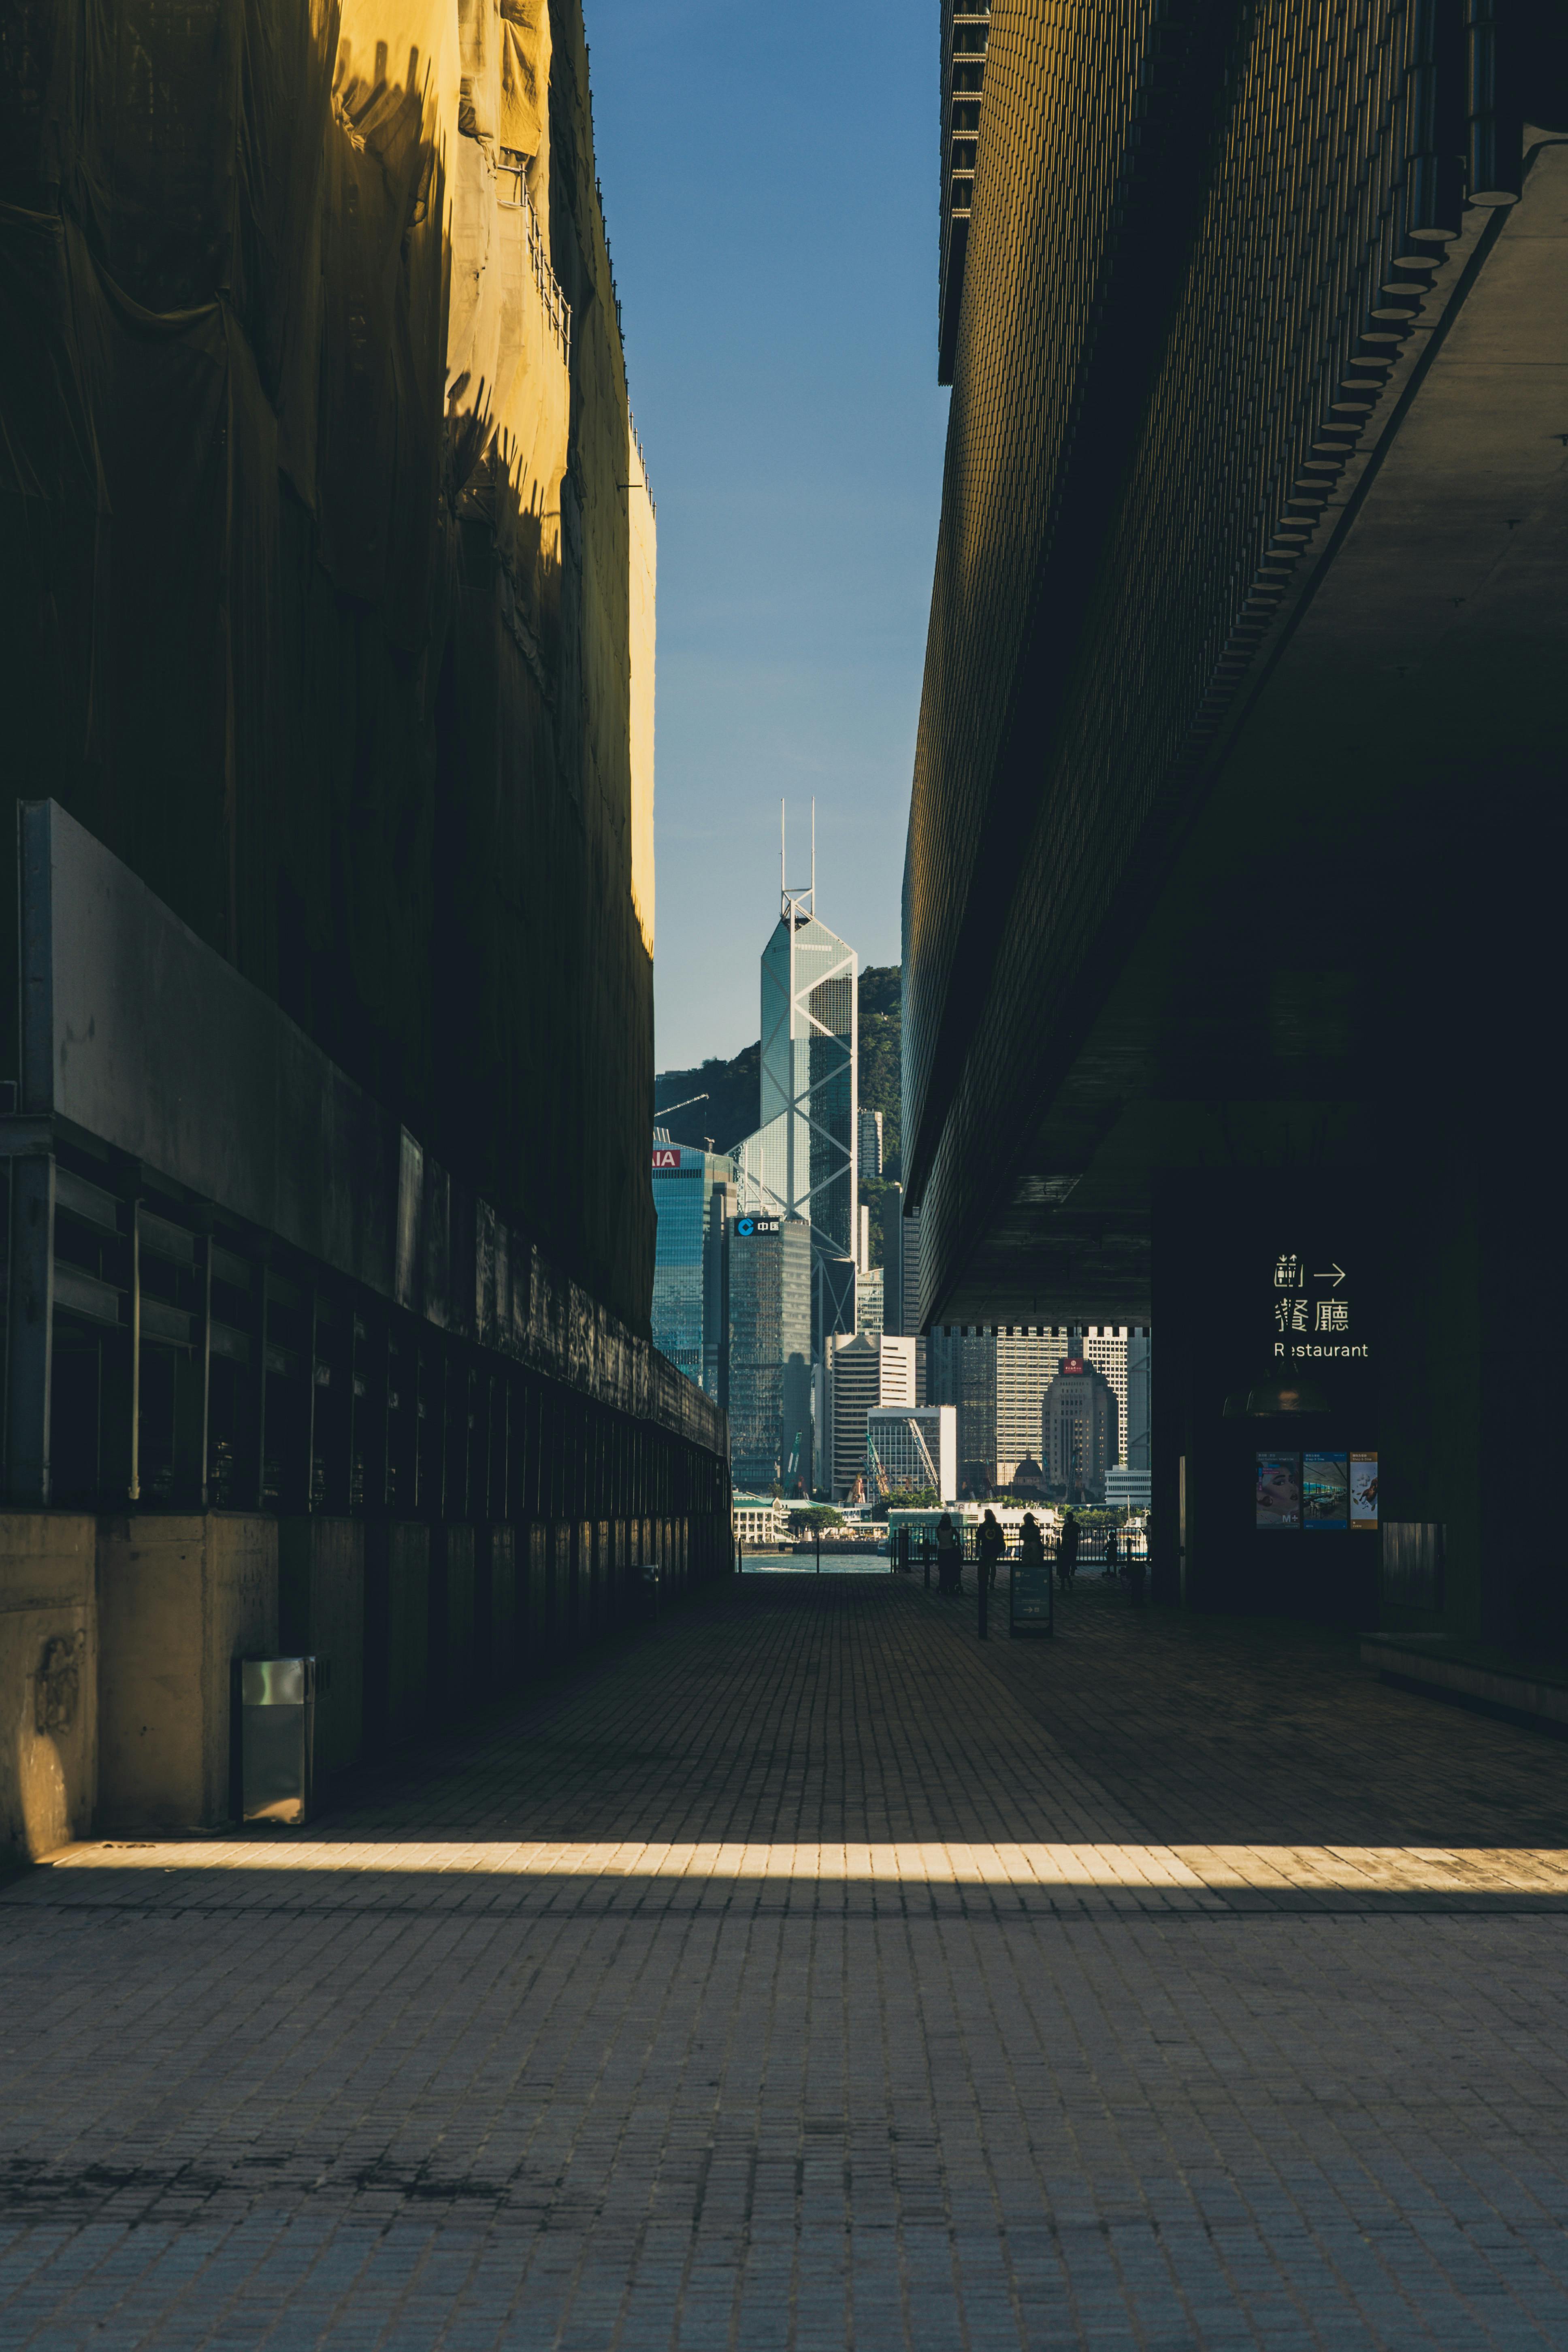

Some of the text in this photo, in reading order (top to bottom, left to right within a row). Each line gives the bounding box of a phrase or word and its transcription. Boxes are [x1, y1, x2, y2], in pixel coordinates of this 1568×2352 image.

[758, 1222, 779, 1231] 中国
[1274, 1297, 1349, 1332] 餐廳
[1282, 1515, 1298, 1523] M+
